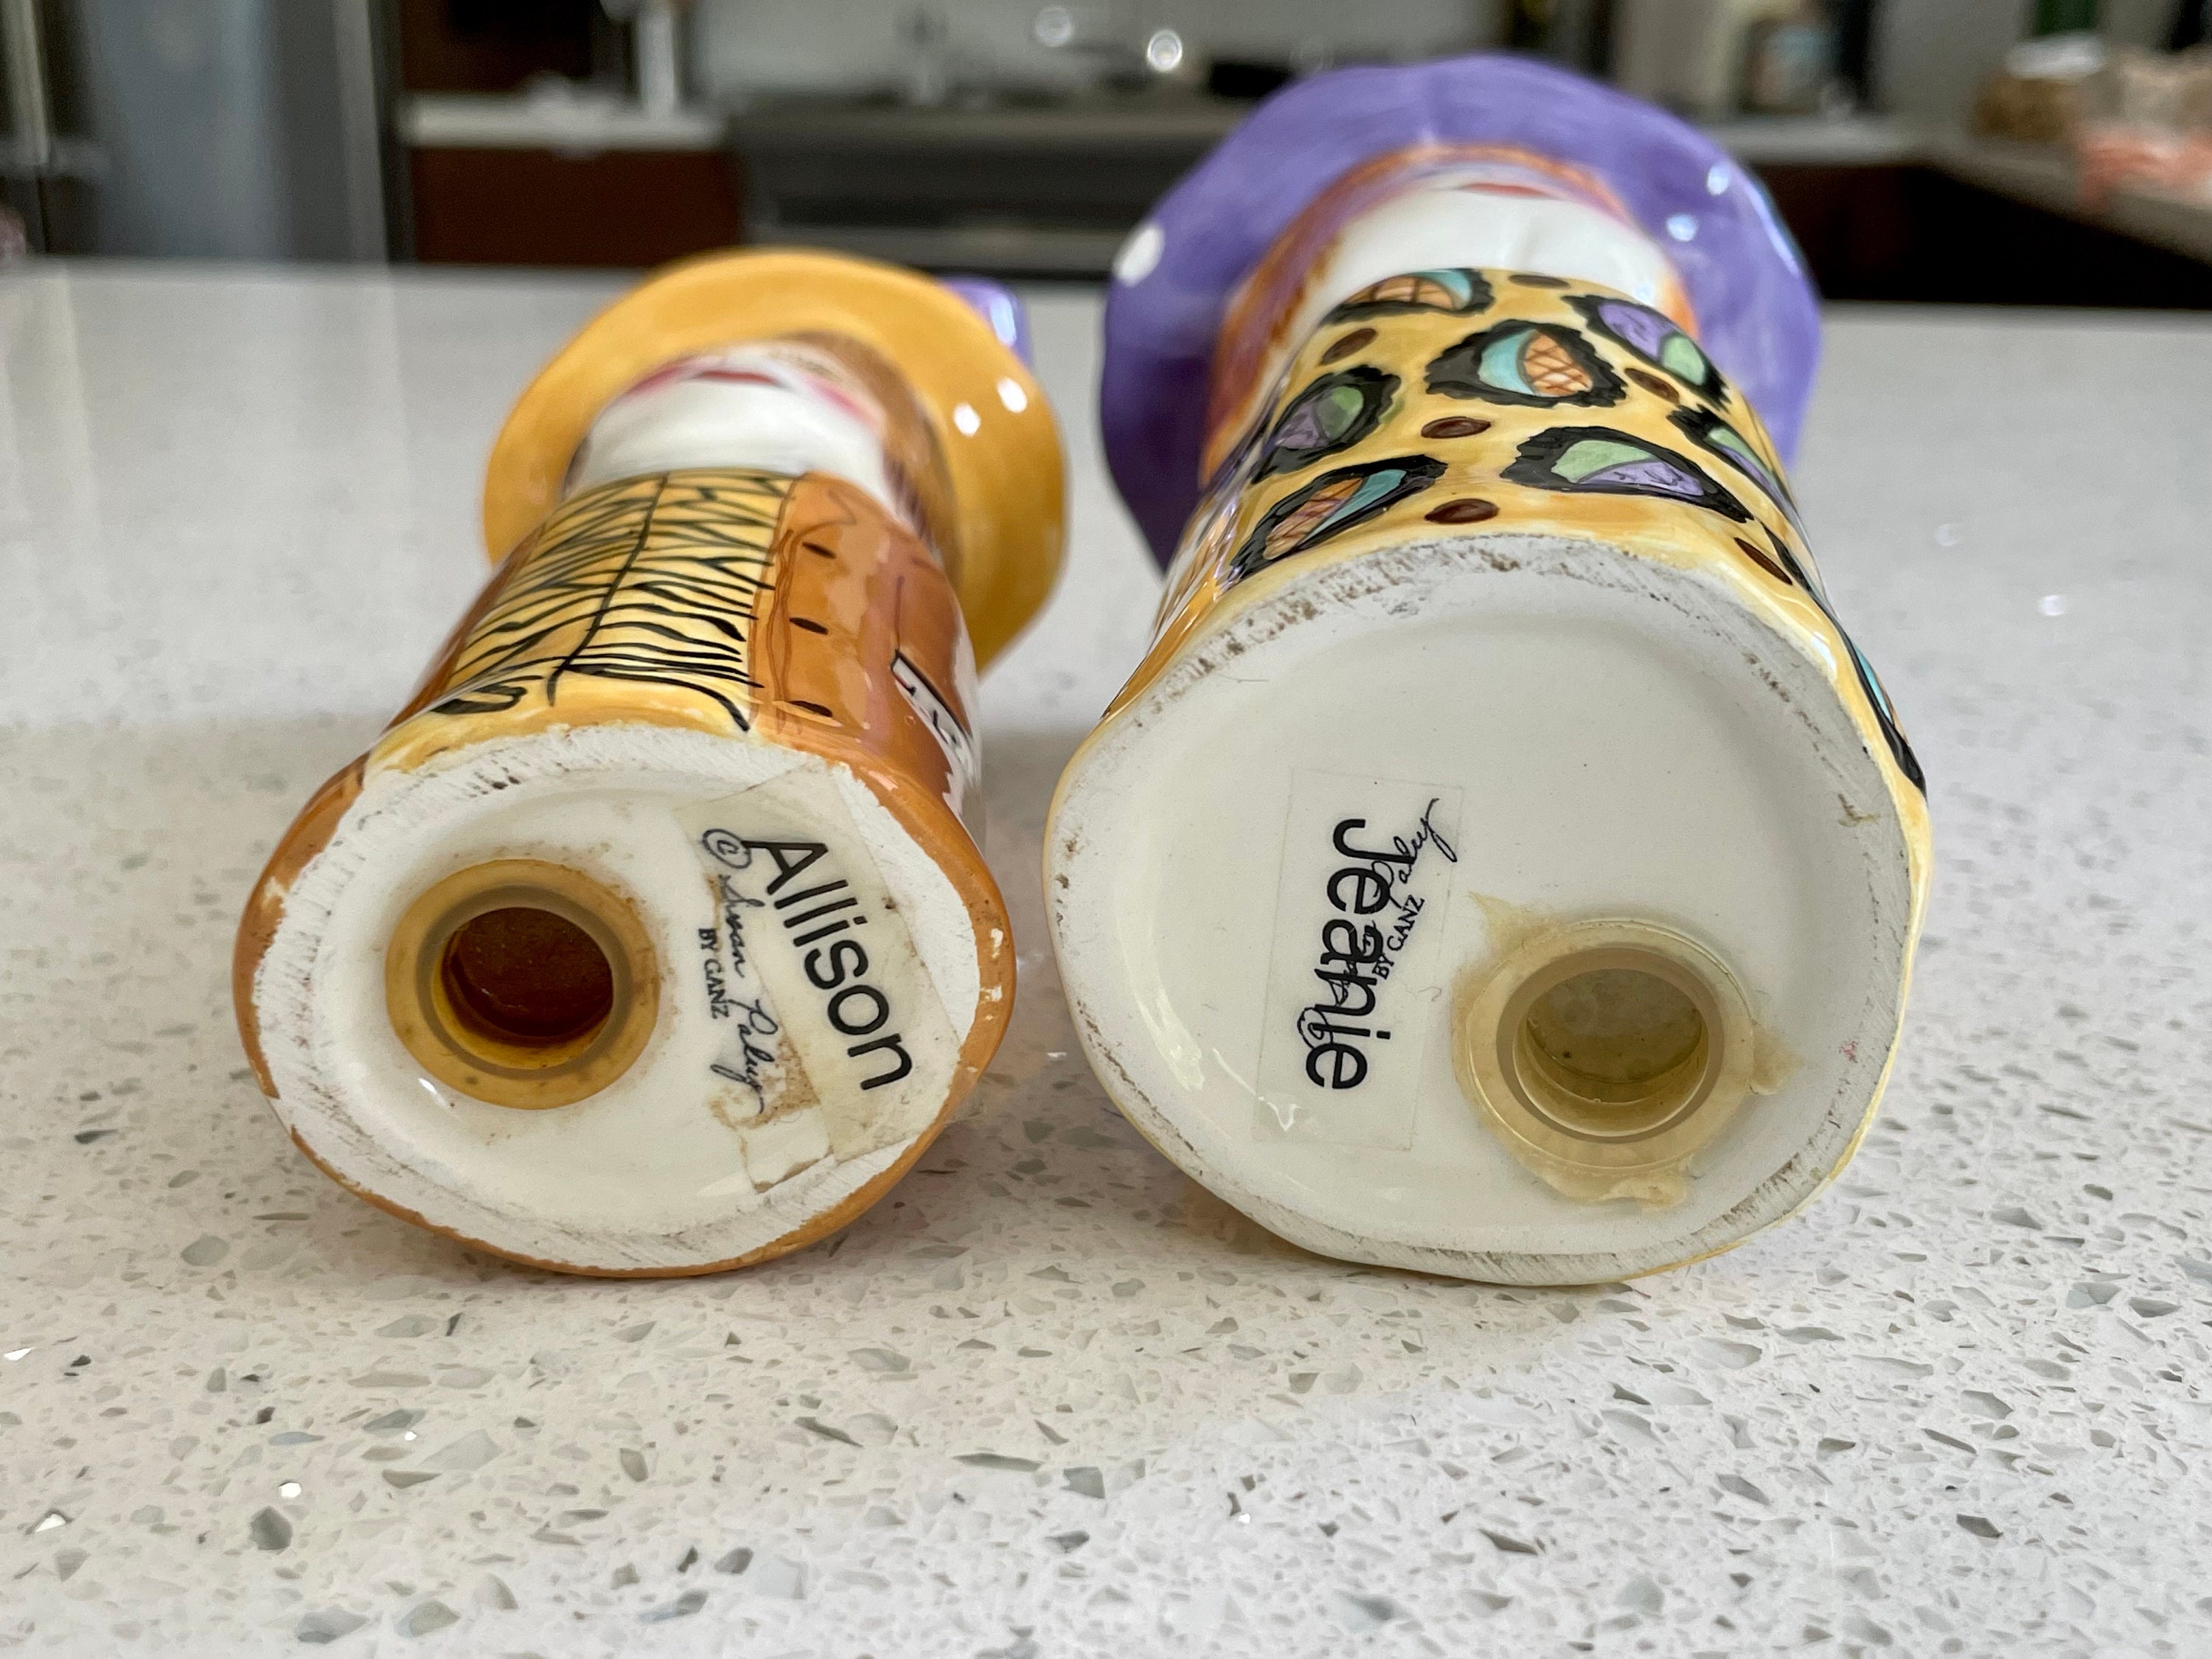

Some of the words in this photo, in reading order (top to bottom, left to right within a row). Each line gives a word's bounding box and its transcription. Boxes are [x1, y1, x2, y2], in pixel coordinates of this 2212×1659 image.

[698, 927, 718, 950] BY
[740, 840, 913, 1091] Allison
[1305, 818, 1414, 1090] Jeanie
[1371, 955, 1394, 980] BY
[1386, 894, 1425, 951] GANZ
[703, 958, 729, 1019] GANZ
